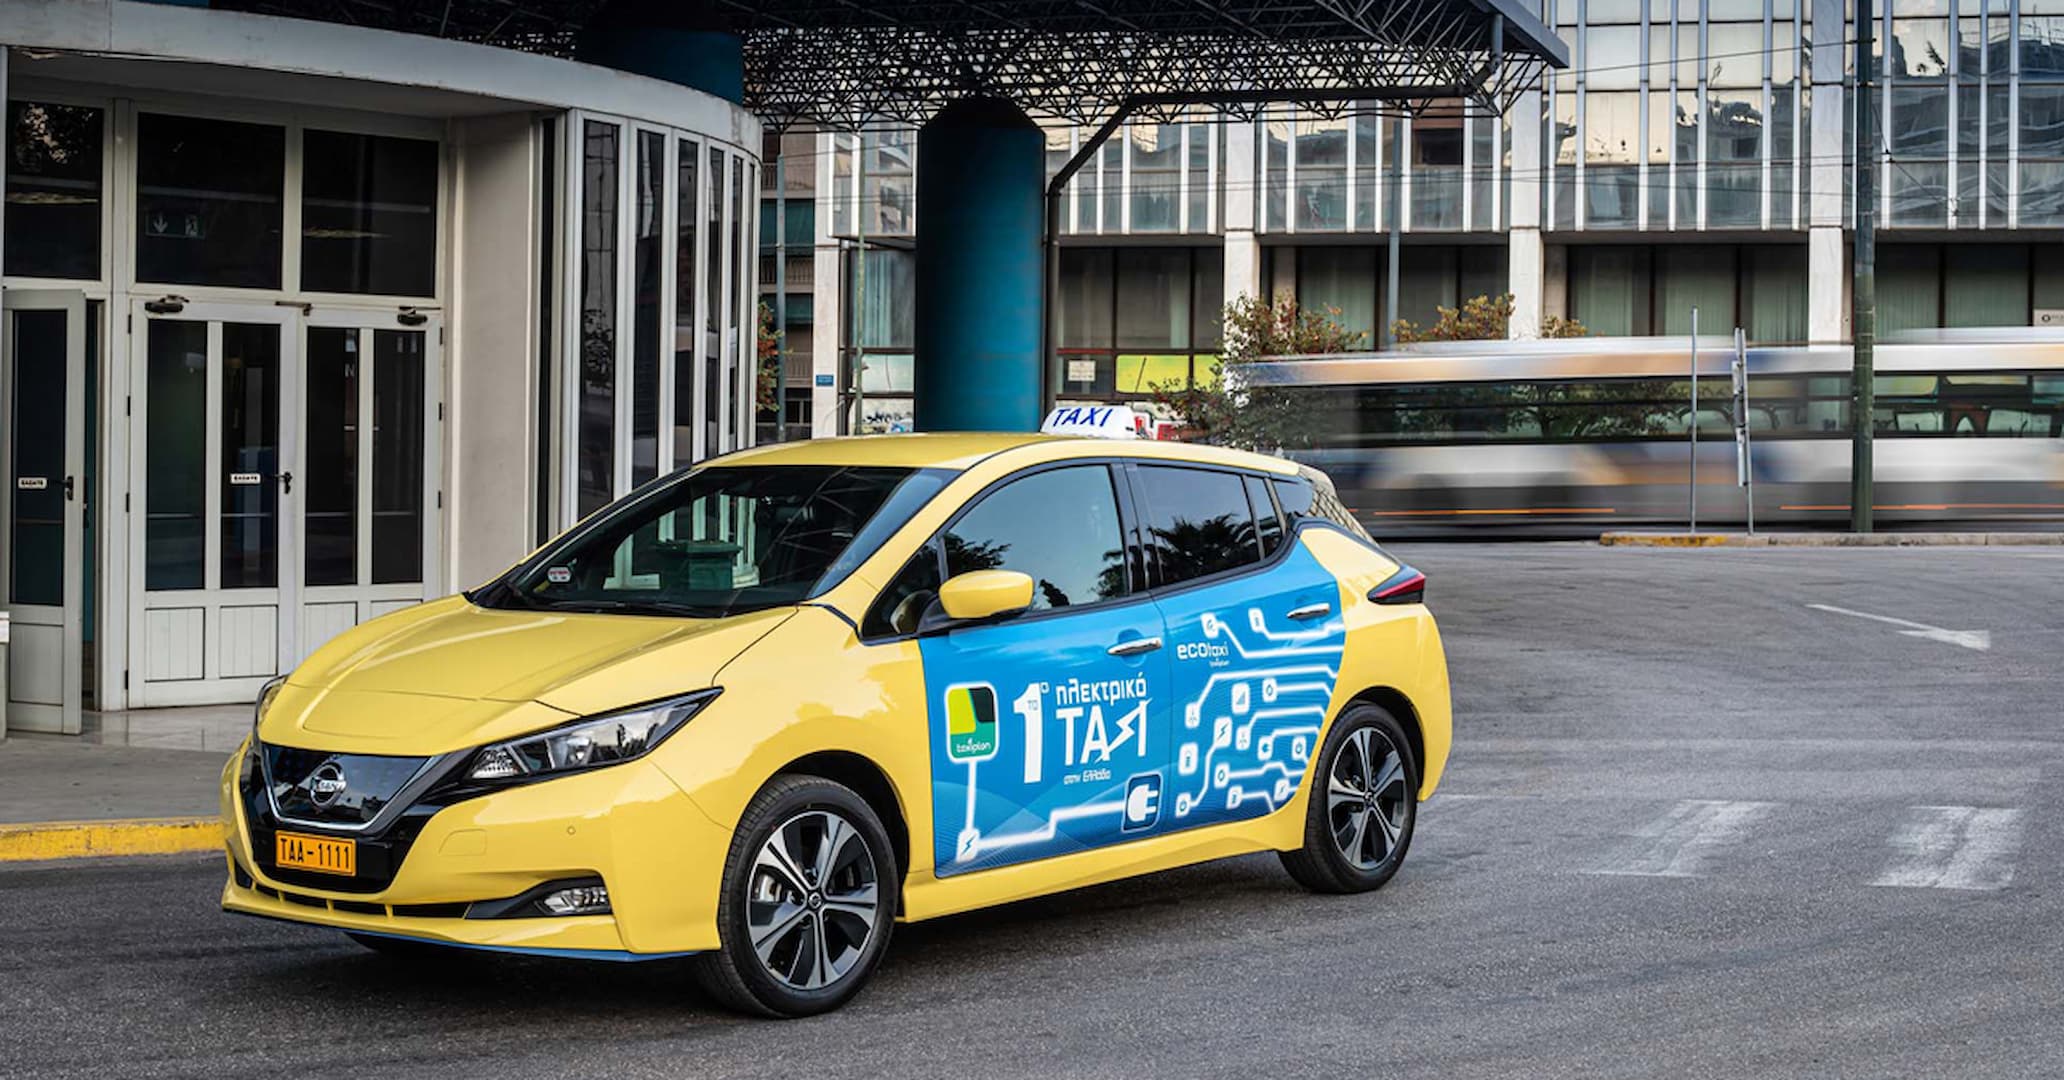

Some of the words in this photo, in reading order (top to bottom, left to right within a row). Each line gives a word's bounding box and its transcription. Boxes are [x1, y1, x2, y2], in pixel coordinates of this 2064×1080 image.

[1053, 407, 1113, 427] TAXI
[1056, 671, 1147, 706] ηλεκτρικό
[280, 838, 349, 869] TAA-1111
